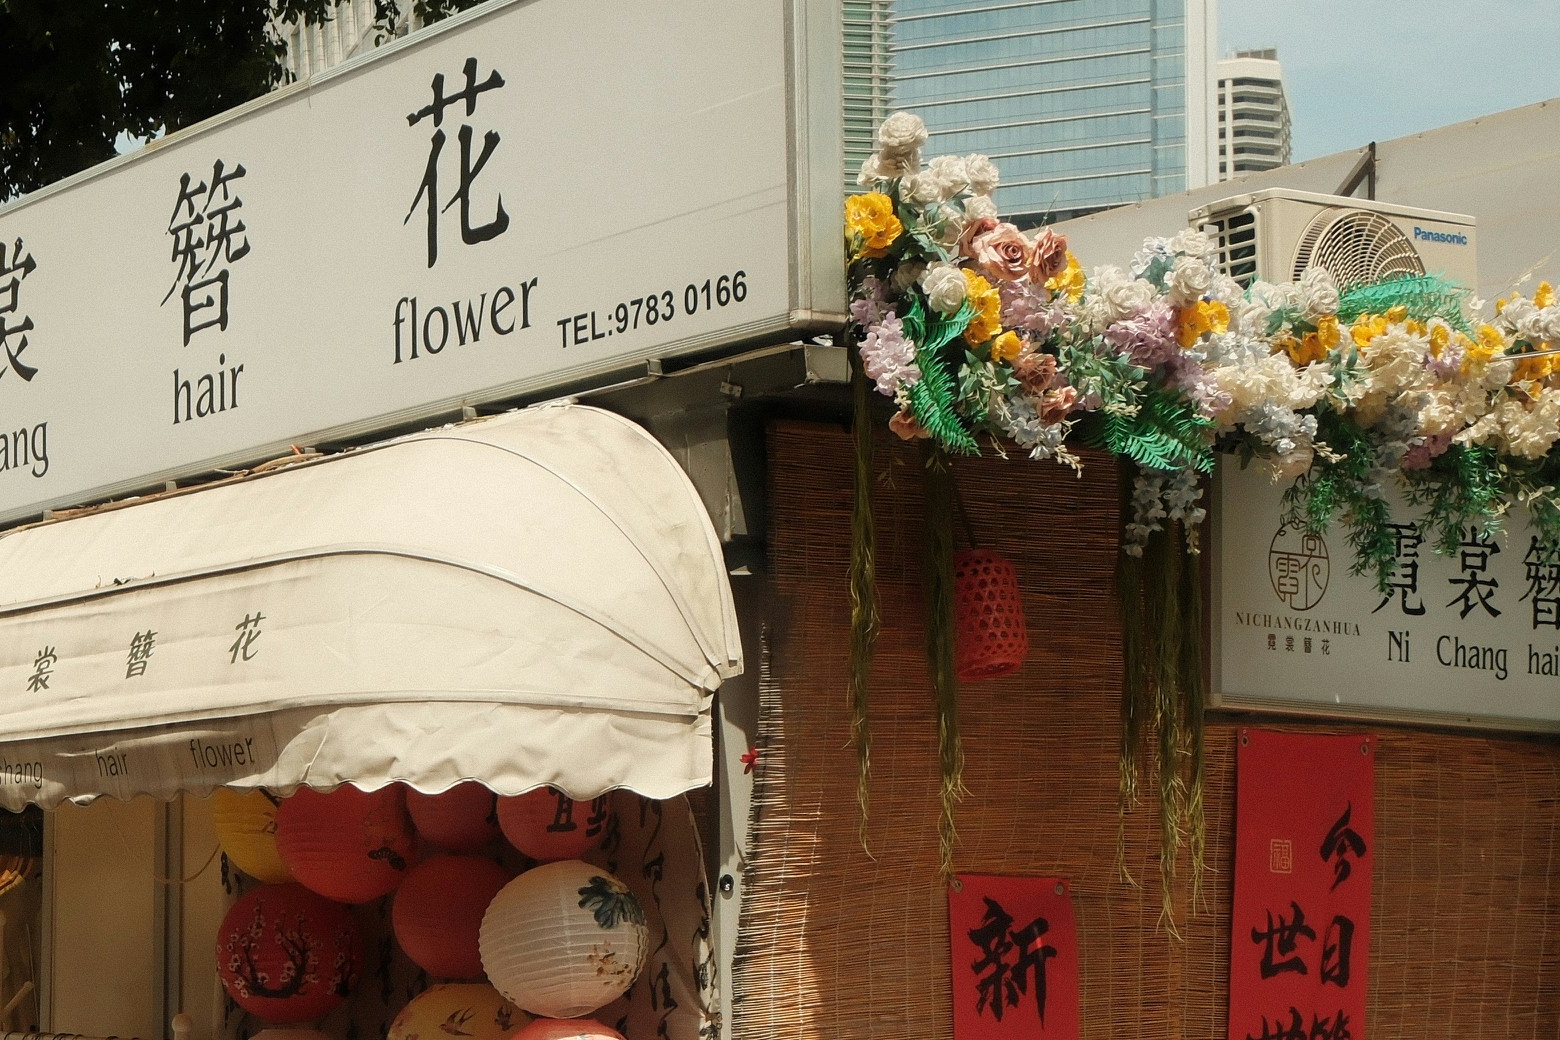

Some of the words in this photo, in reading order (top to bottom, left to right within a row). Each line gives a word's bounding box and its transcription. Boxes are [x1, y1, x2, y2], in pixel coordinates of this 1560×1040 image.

[1414, 226, 1468, 246] Panasonic
[557, 285, 675, 350] TEL:9783
[685, 269, 749, 317] 0166
[173, 353, 245, 426] hair
[393, 277, 538, 365] flower
[1235, 611, 1361, 637] NICHANGZANHUA
[1387, 630, 1411, 663] Ni
[1436, 635, 1509, 681] Chang
[95, 747, 128, 778] hair
[189, 735, 256, 770] flower
